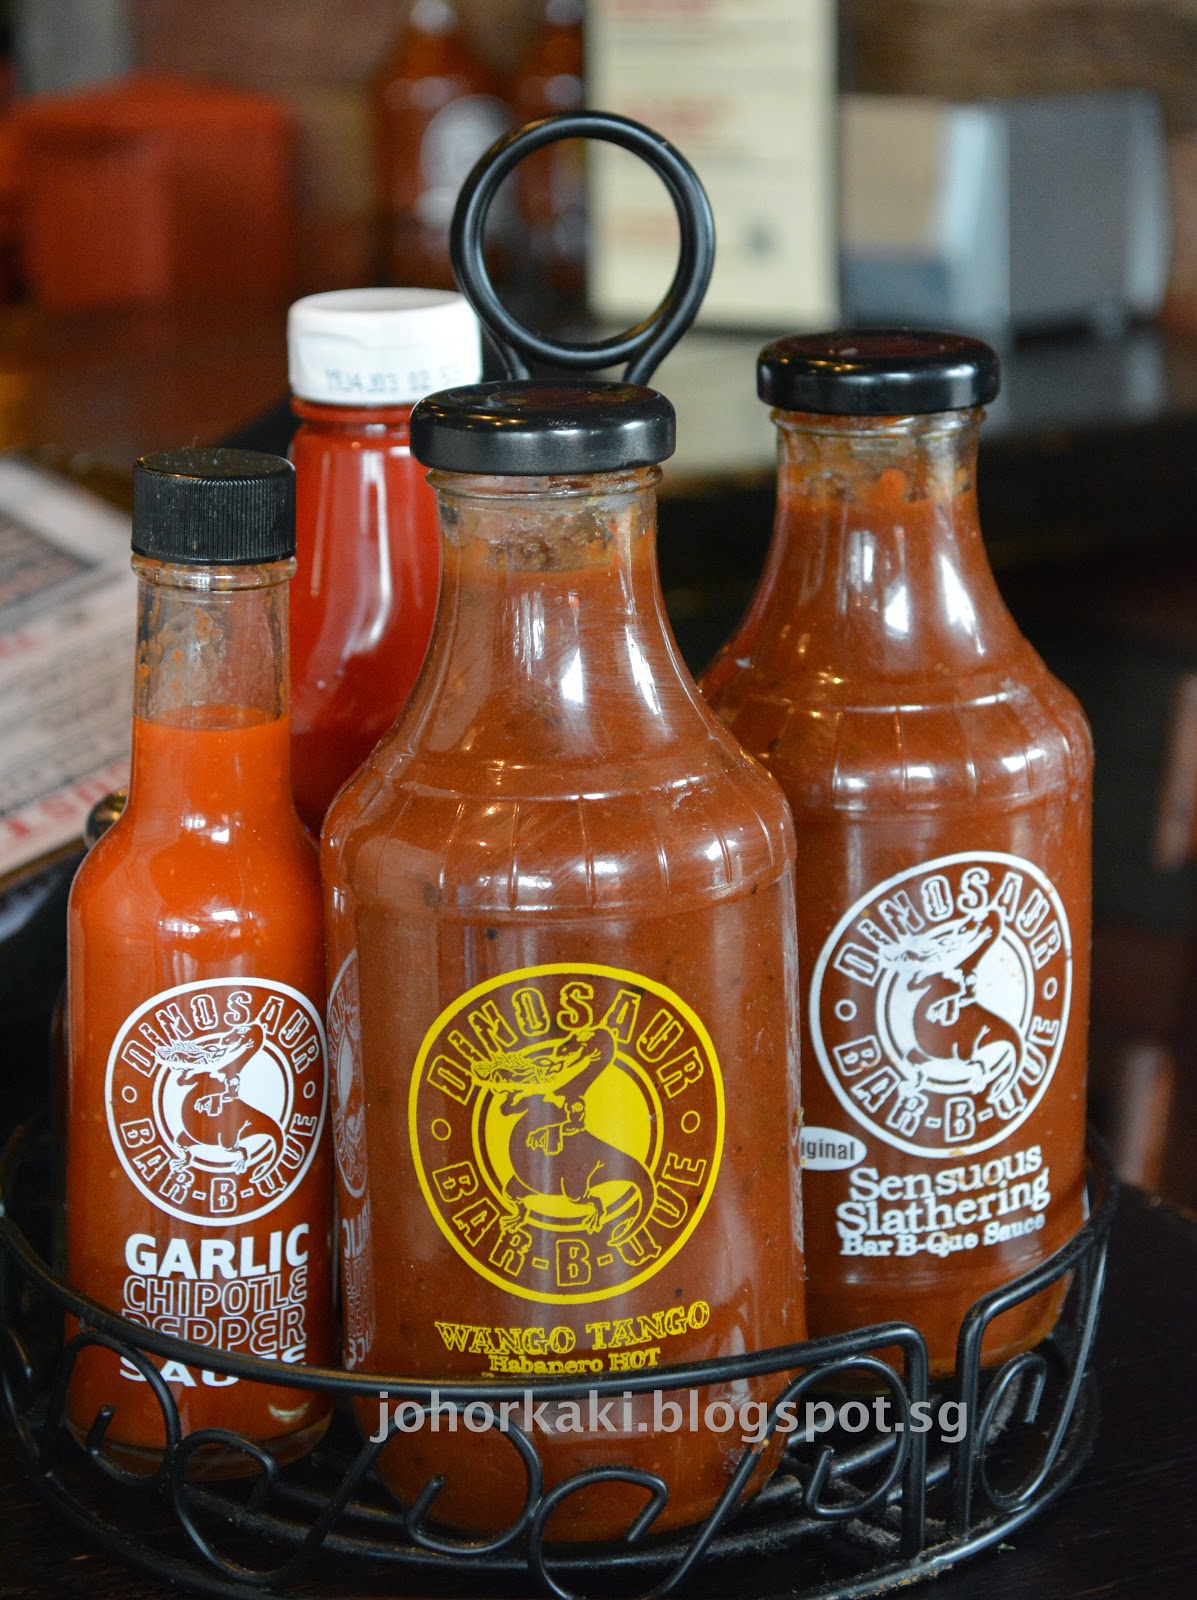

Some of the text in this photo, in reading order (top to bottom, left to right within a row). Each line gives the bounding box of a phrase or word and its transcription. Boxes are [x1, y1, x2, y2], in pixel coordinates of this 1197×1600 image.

[833, 867, 1062, 987] DINOSAUR
[120, 991, 320, 1077] DINOSAUR
[427, 982, 703, 1105] DINOSAUR
[833, 1016, 1060, 1142] BAR-B-QUE
[120, 1113, 317, 1213] BAR-B-QUE
[801, 1138, 854, 1160] iginal
[849, 1145, 1042, 1201] Sensuous
[432, 1153, 706, 1286] BAR-B-QUE
[836, 1167, 1051, 1239] Slathering
[840, 1213, 1045, 1257] Bar B-Que Sauce
[124, 1223, 309, 1280] GARLIC
[123, 1266, 308, 1317] CHIPOTLE
[434, 1301, 710, 1355] WANGO TANGO
[488, 1347, 661, 1375] Habanero HOT
